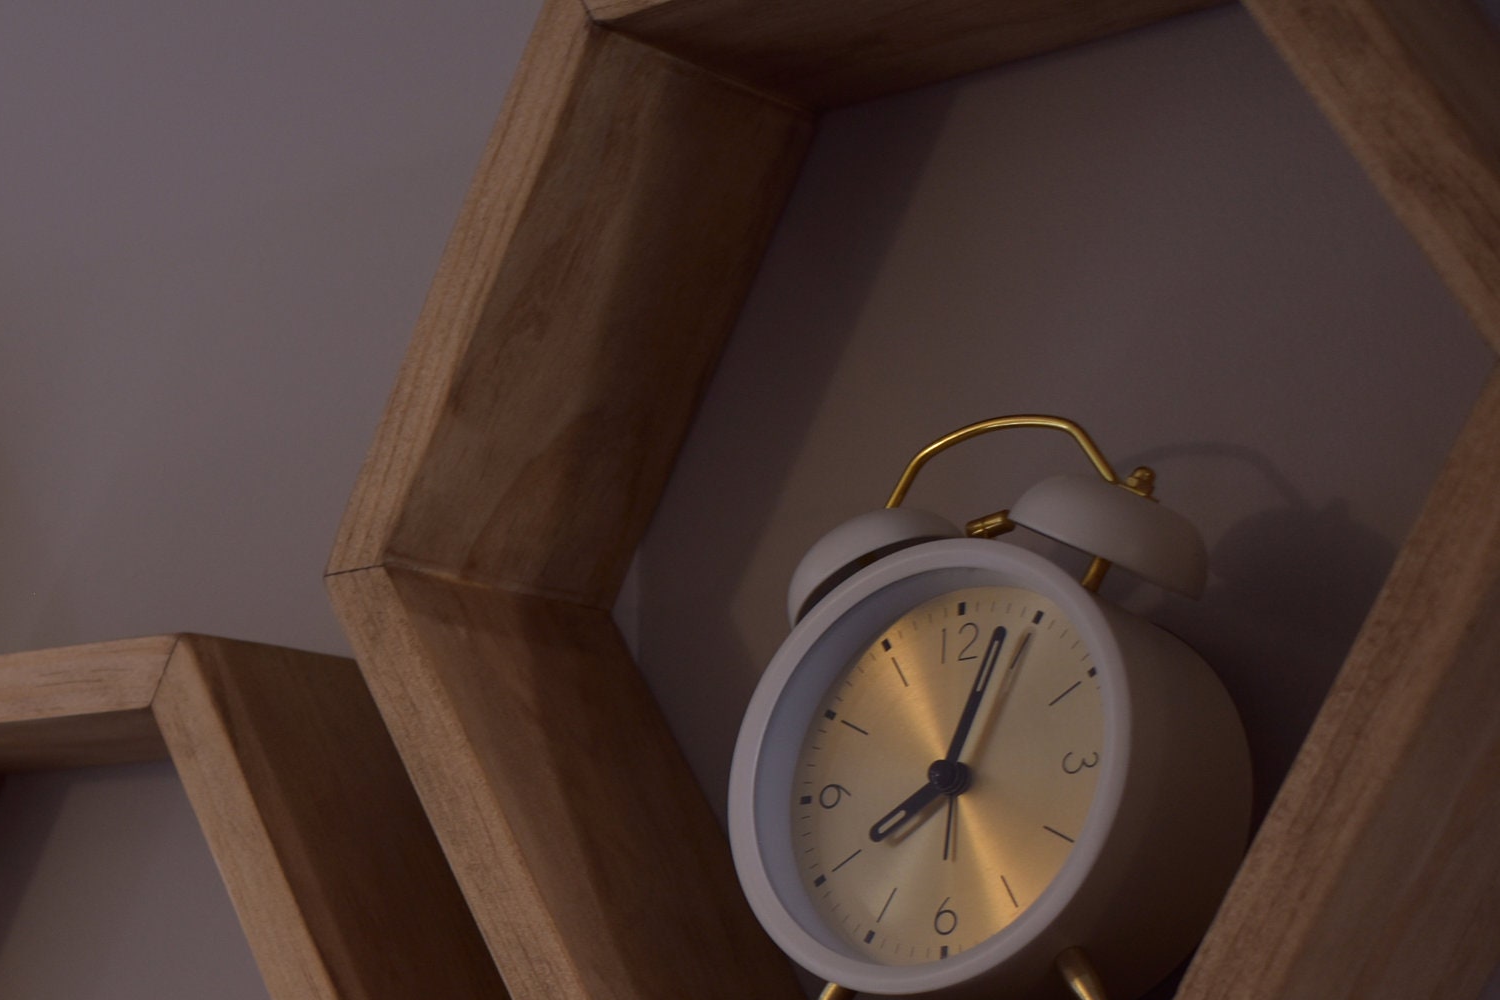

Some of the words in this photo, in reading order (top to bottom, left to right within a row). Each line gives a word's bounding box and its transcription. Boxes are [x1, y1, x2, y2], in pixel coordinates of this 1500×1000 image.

[941, 622, 980, 663] 12
[1062, 750, 1098, 775] 3
[819, 783, 851, 810] 9
[933, 896, 958, 936] 6
